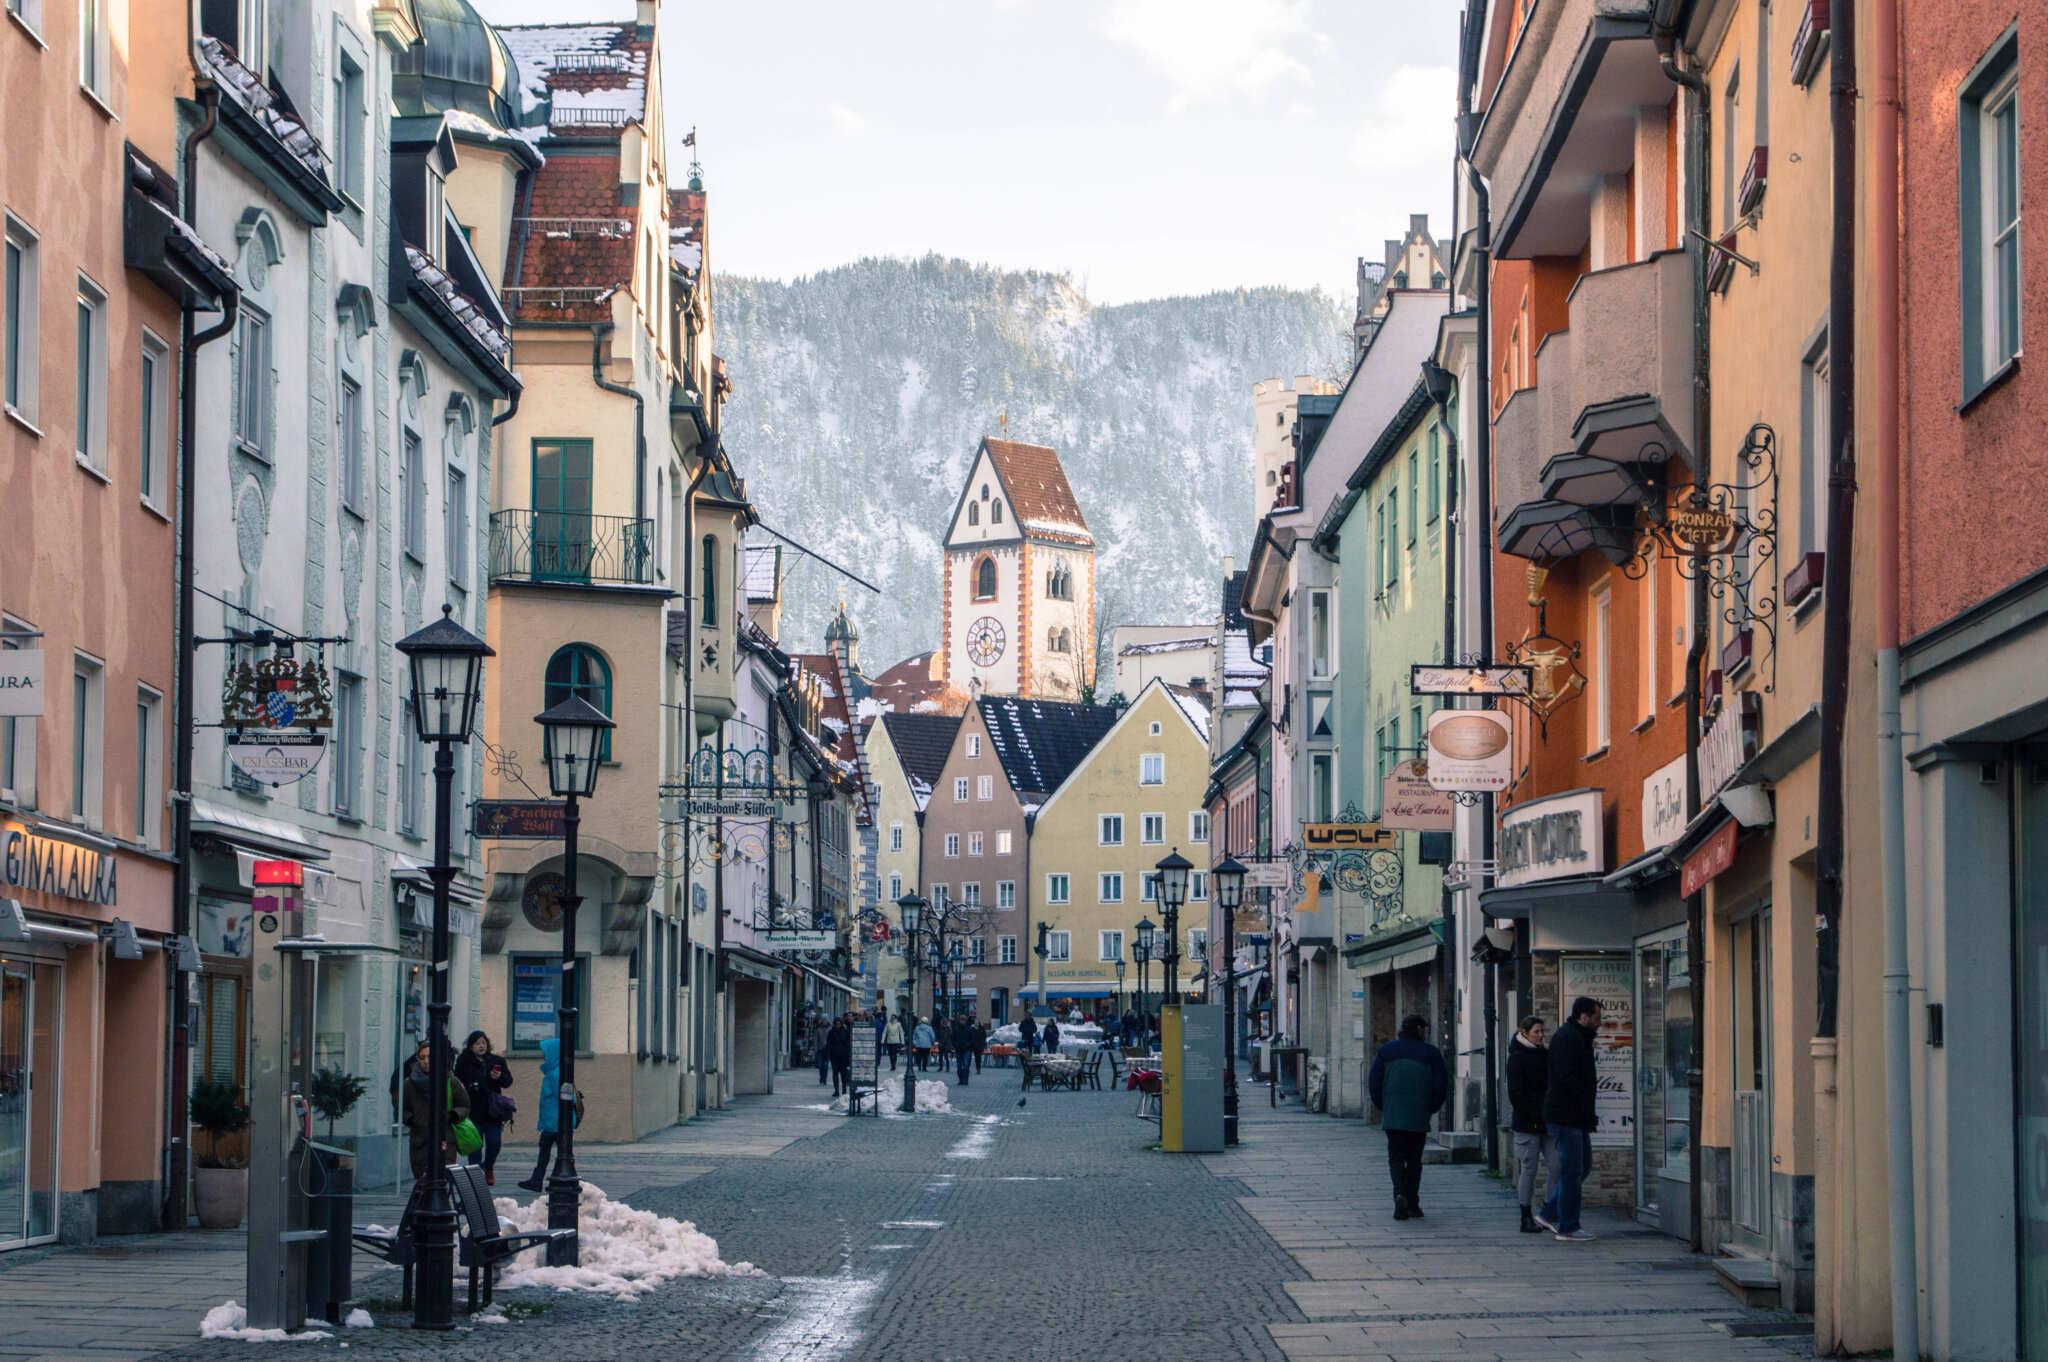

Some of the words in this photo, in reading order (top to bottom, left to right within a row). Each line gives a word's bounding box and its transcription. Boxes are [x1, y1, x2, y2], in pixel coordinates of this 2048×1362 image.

[1678, 512, 1733, 527] KONRAD
[1678, 526, 1720, 543] METZ
[259, 735, 280, 744] Ludwig
[1398, 789, 1439, 797] RESTAURANT
[1386, 801, 1414, 816] Asia
[522, 819, 555, 832] Wolf
[1308, 829, 1391, 843] WOLF
[1572, 963, 1595, 972] CITY
[1585, 974, 1616, 984] HOTEL
[1597, 998, 1629, 1011] KEBAB
